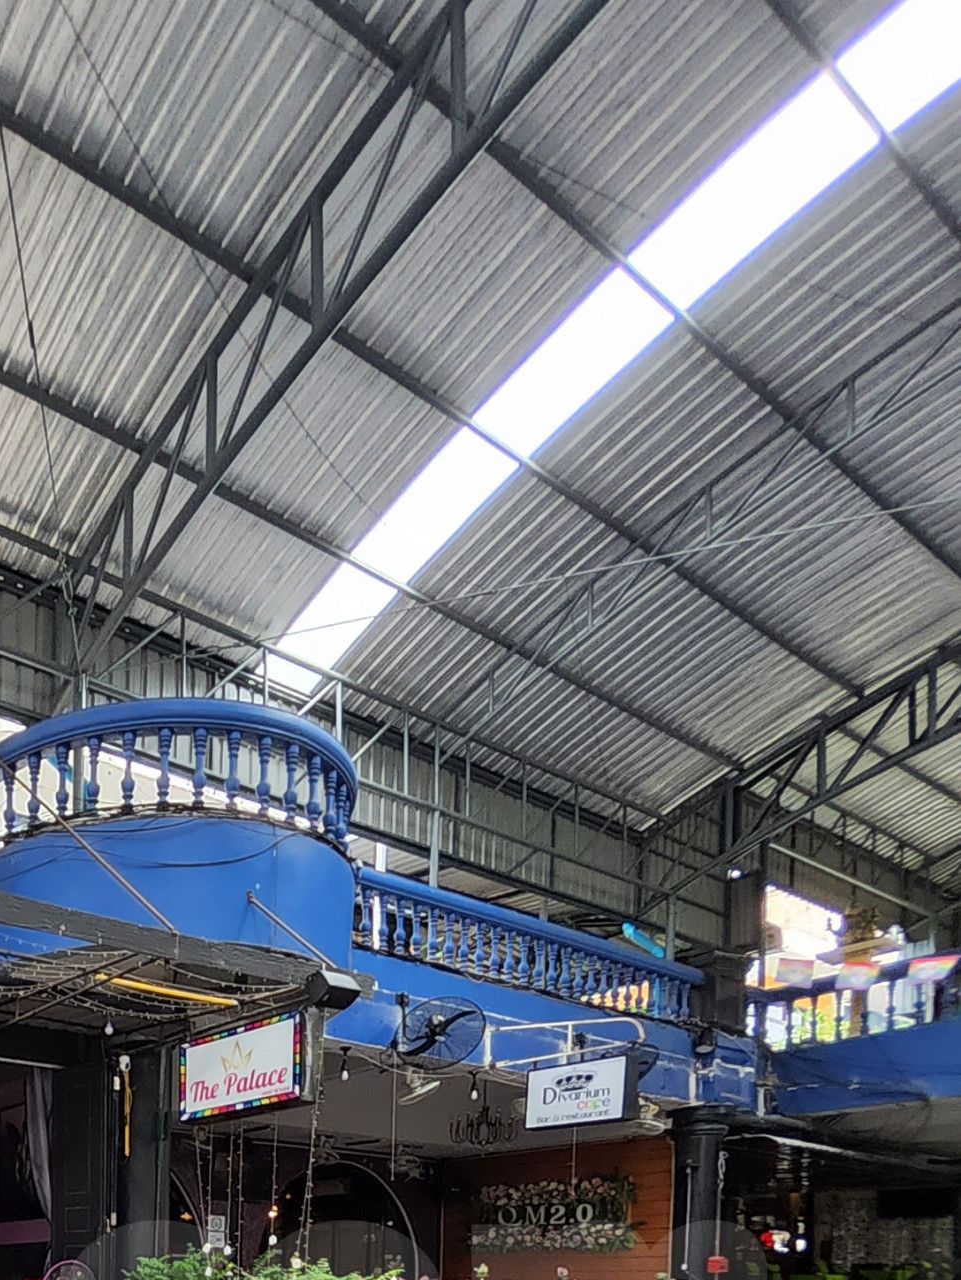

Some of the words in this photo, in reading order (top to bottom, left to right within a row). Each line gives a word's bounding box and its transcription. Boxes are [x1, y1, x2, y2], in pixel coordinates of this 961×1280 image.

[190, 1080, 219, 1103] The
[224, 1067, 287, 1096] Palace
[542, 1087, 611, 1105] Divarium
